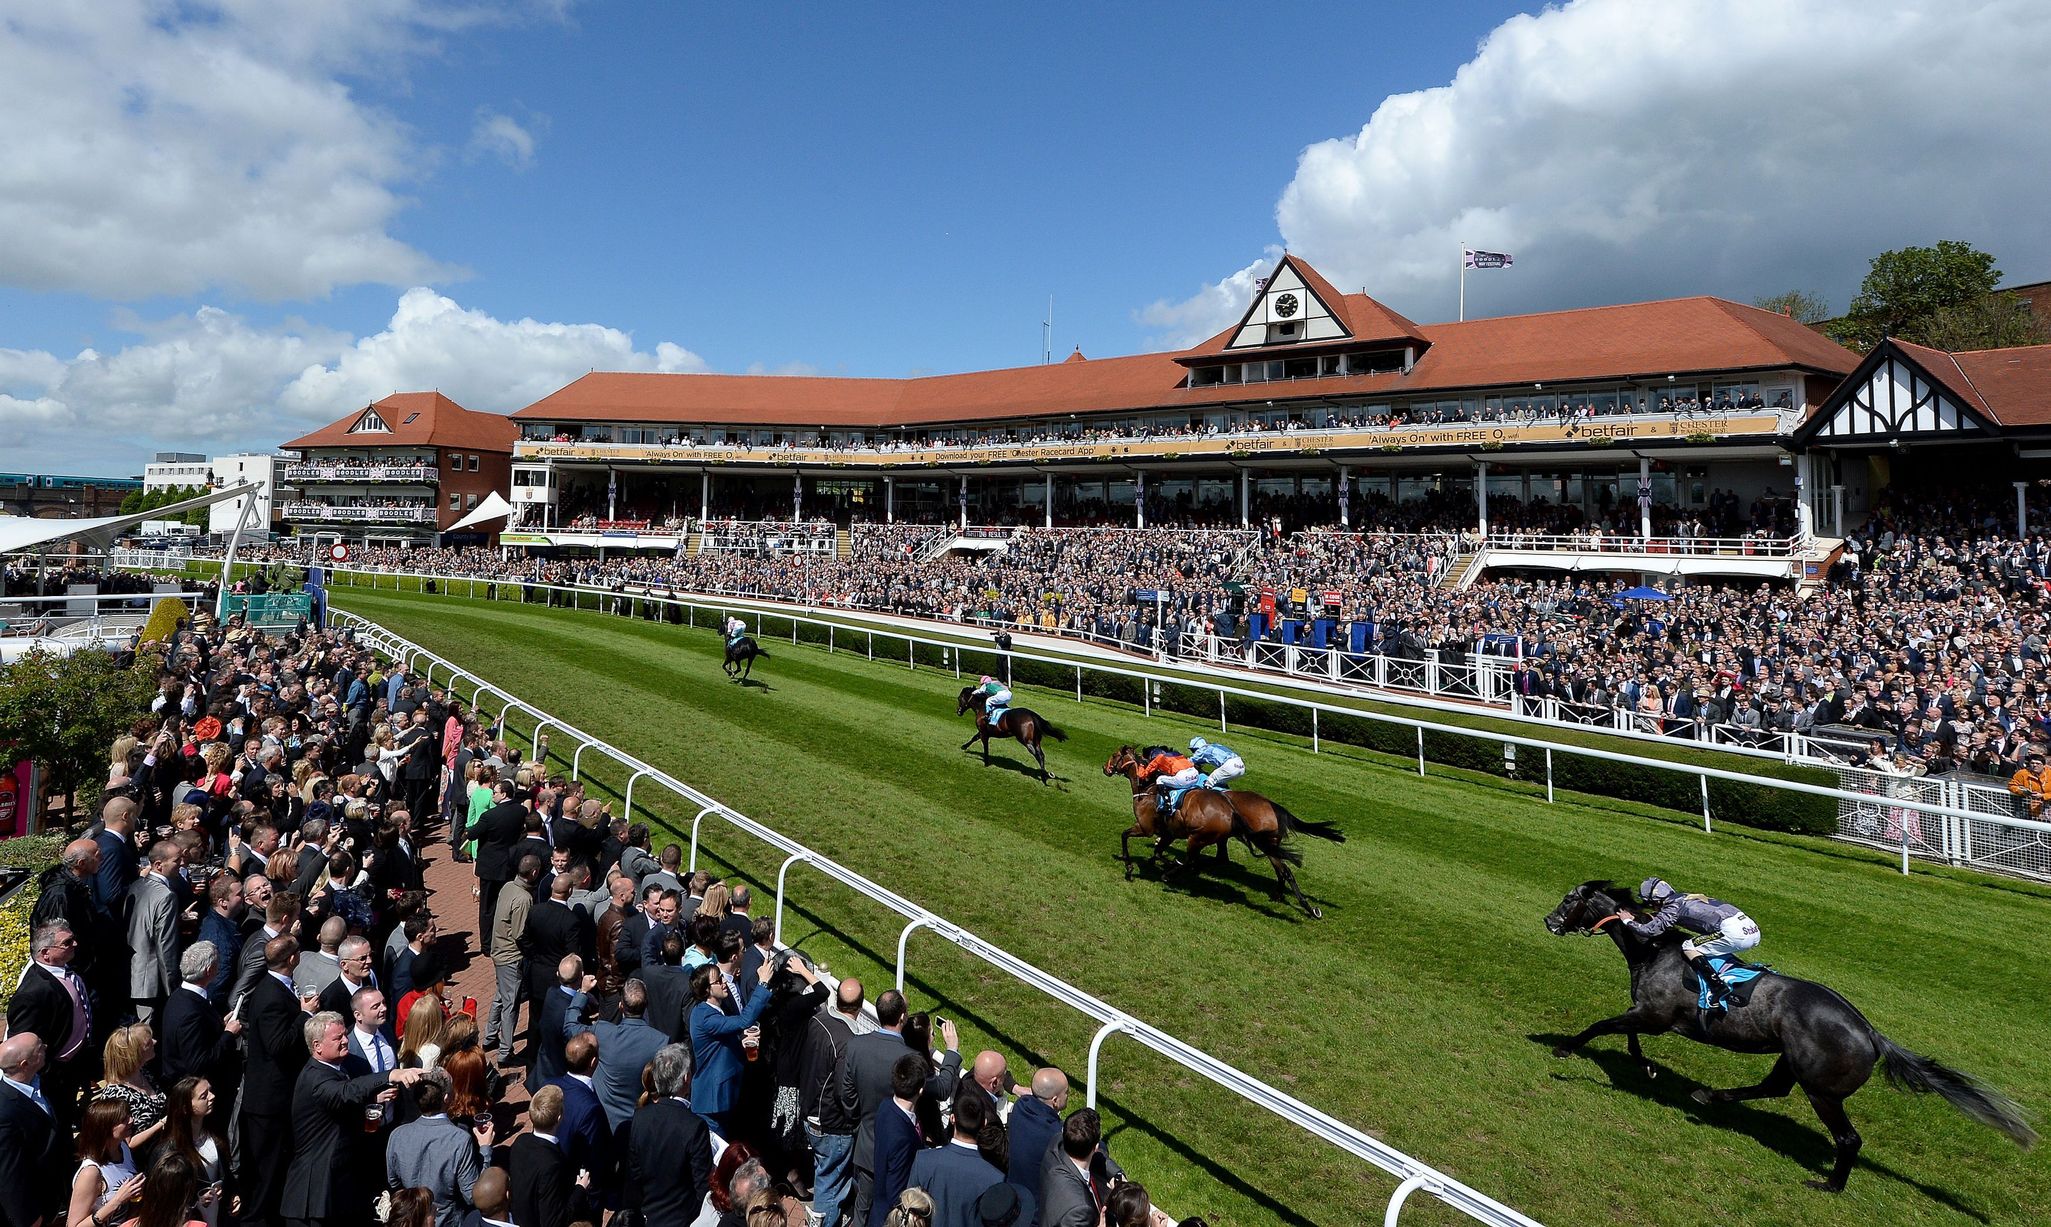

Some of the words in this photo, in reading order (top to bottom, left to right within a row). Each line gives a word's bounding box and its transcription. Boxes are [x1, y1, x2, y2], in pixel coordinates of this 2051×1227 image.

[1581, 424, 1638, 437] betfair
[1680, 420, 1728, 428] CHESTER
[1236, 439, 1275, 449] betfair
[1369, 435, 1406, 445] 'Always
[1409, 434, 1428, 443] On'
[1430, 432, 1454, 442] with
[1456, 431, 1486, 440] FREE
[544, 447, 575, 456] betfair
[935, 452, 968, 460] Download
[970, 452, 985, 460] your
[1040, 447, 1075, 456] Racecard
